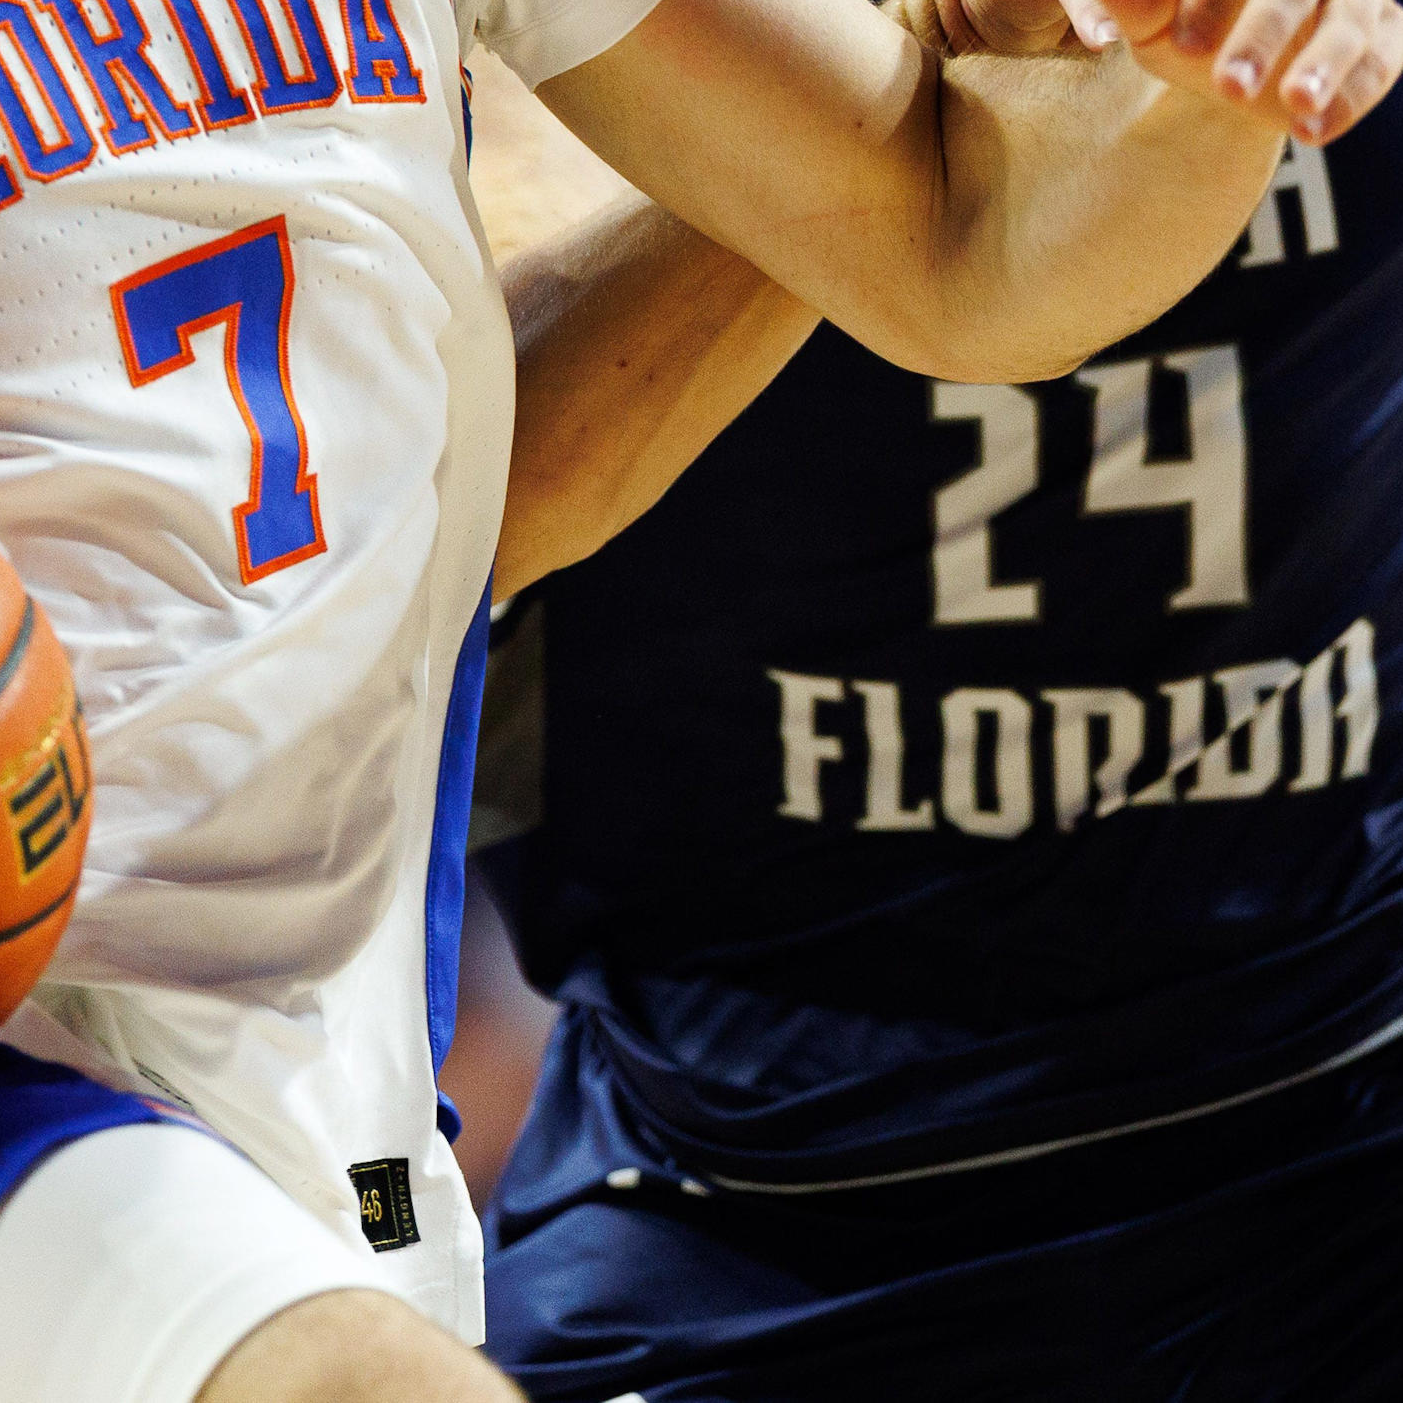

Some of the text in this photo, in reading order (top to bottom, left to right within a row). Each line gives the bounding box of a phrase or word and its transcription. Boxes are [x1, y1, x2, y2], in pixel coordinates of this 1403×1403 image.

[109, 214, 327, 585] 7
[932, 345, 1248, 625] 24
[766, 616, 1379, 841] FLORIDA
[361, 1188, 383, 1223] 46
